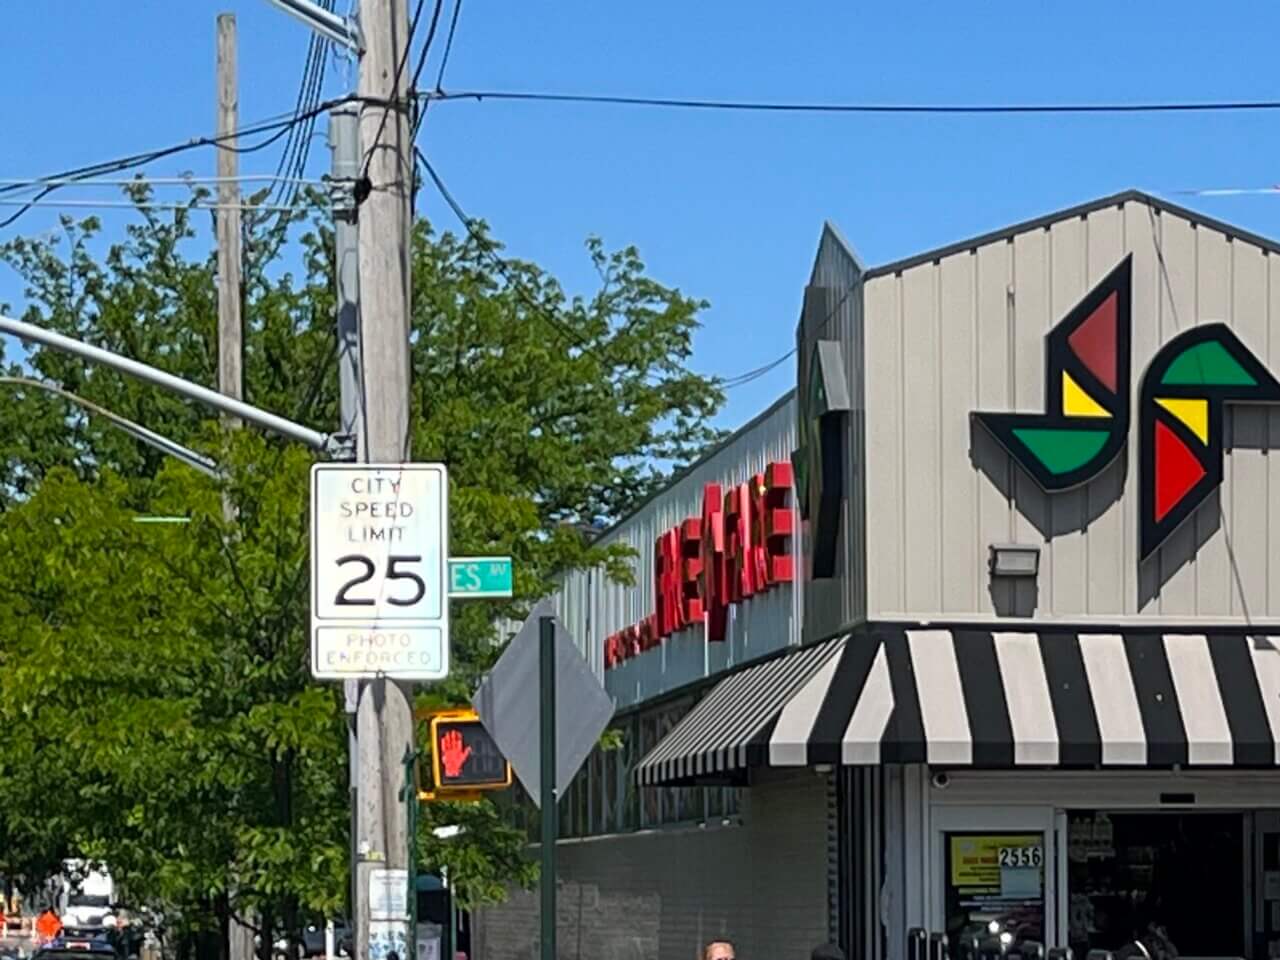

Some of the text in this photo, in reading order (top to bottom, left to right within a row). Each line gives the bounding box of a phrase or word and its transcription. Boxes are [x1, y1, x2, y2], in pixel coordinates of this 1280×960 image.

[351, 478, 401, 494] CITY
[340, 502, 413, 518] SPEED
[348, 526, 406, 542] LIMIT
[334, 554, 426, 606] 25
[346, 632, 410, 648] PHOTO
[326, 650, 431, 665] ENFORCED
[1000, 847, 1041, 866] 2556
